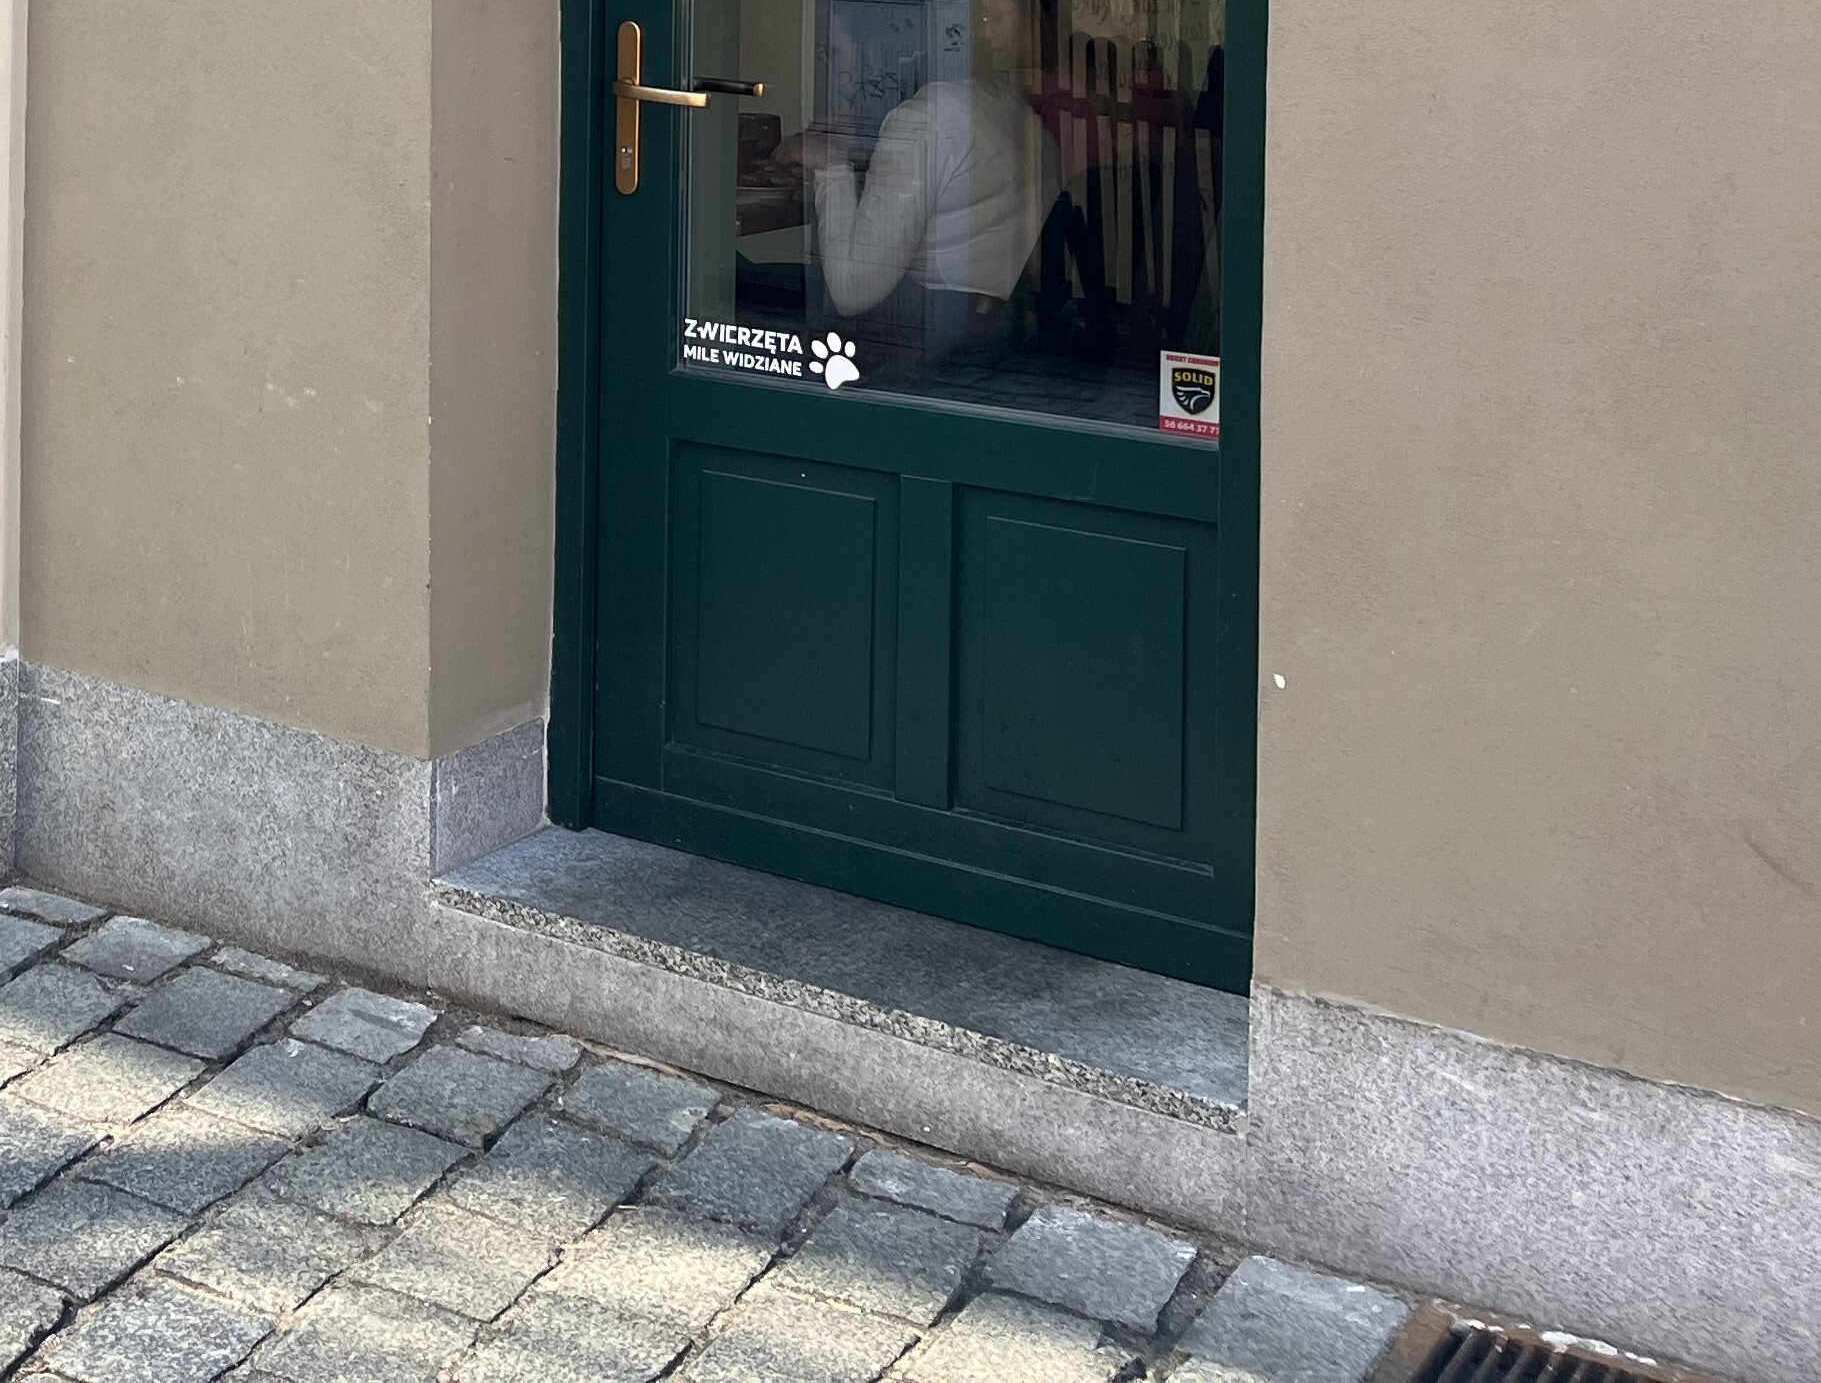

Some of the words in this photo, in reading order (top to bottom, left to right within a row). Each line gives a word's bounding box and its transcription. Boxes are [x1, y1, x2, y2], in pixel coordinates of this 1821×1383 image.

[683, 344, 720, 364] MILE
[722, 350, 803, 377] WIDZIANE
[1174, 371, 1213, 386] SOLID
